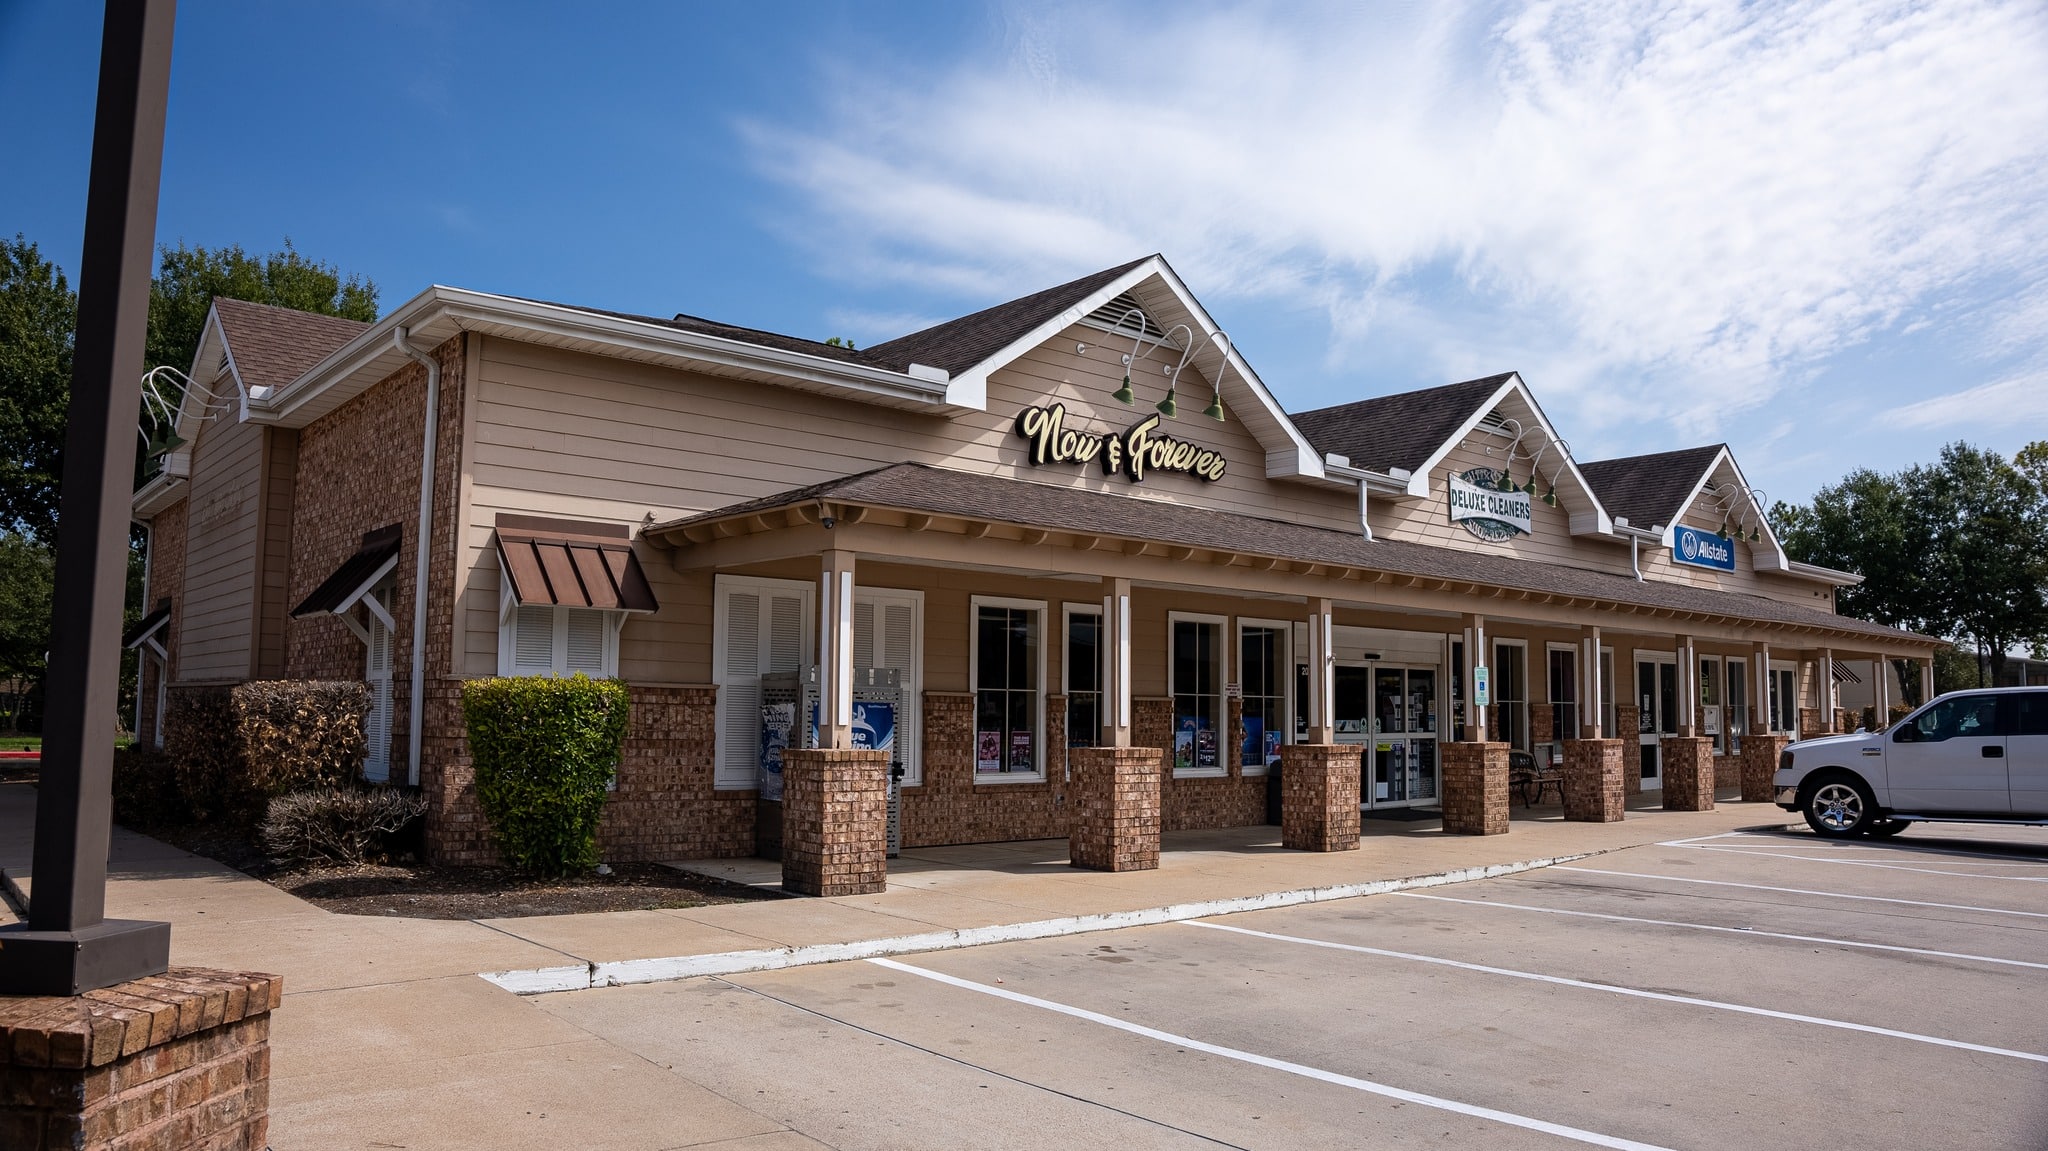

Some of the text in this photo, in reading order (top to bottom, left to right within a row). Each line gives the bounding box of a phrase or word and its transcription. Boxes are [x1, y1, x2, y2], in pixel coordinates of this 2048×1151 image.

[1018, 402, 1101, 465] Now
[1128, 413, 1226, 482] Forever
[1451, 488, 1530, 520] DELUXE CLEANERS
[1698, 541, 1728, 562] Allstate
